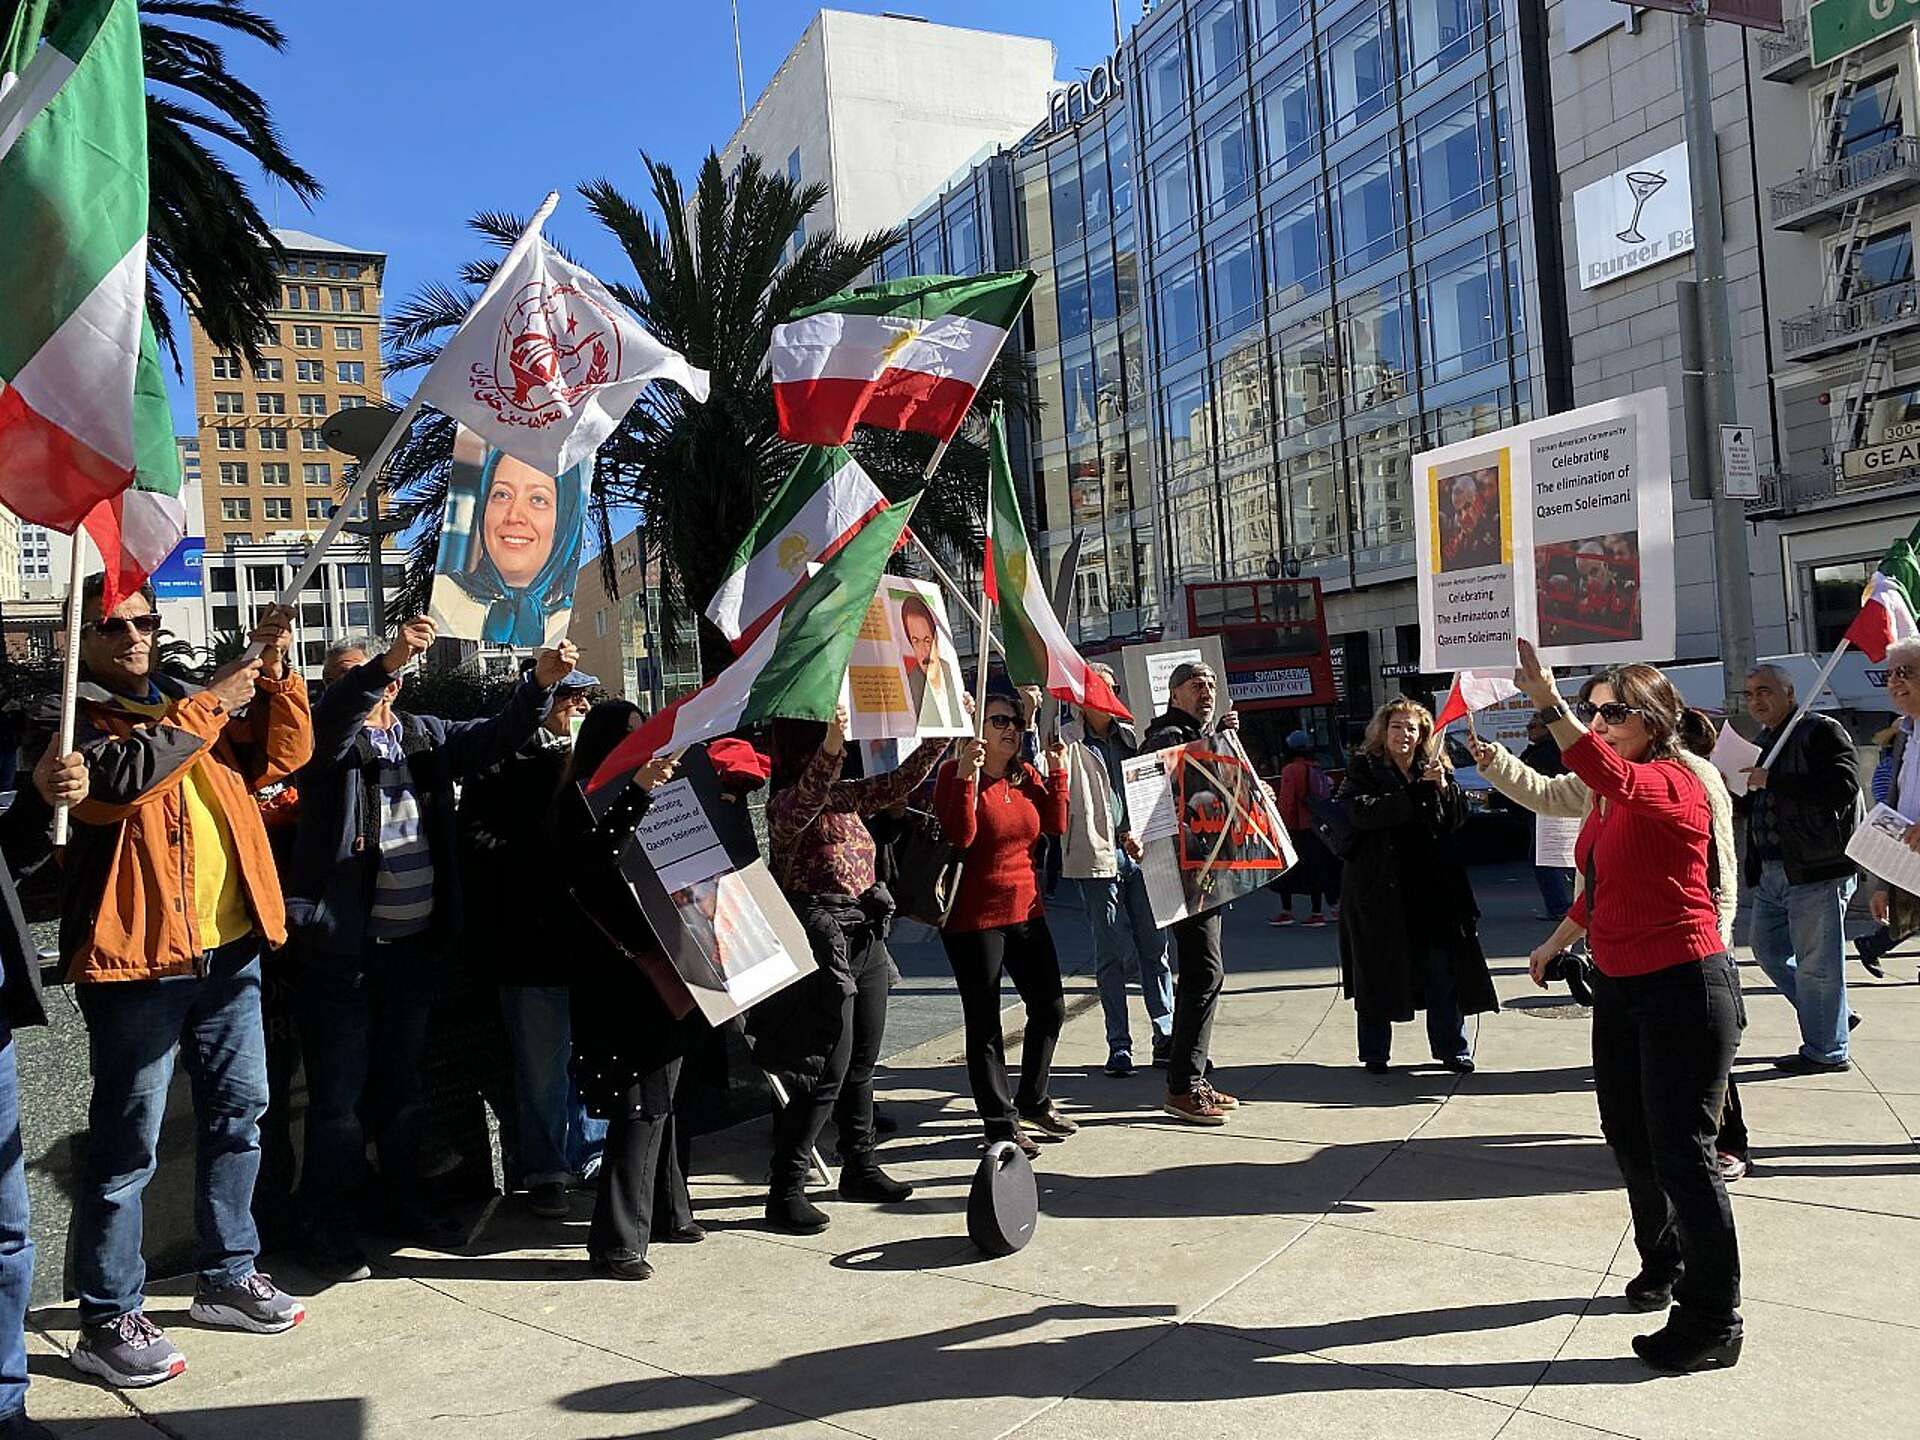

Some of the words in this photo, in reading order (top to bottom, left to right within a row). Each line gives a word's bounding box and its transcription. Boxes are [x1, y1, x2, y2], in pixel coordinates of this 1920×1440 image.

[1588, 240, 1662, 281] Burger
[1558, 436, 1587, 448] American
[1588, 427, 1627, 441] Community
[1552, 448, 1609, 469] Celebrating
[1865, 443, 1920, 468] GEA
[1536, 481, 1555, 495] The
[1556, 470, 1615, 491] elimination
[1617, 464, 1630, 479] of
[1537, 503, 1573, 518] Qasem
[1575, 488, 1632, 511] Soleimani
[1448, 589, 1494, 604] Celebrating
[1437, 613, 1451, 624] The
[1453, 608, 1499, 623] elimination
[1501, 605, 1511, 619] of
[1438, 634, 1466, 647] Qasem
[1467, 629, 1512, 644] Soleimani
[1255, 668, 1310, 682] SIGHTSEEING
[1383, 665, 1408, 675] RETAIL
[1250, 684, 1264, 695] ON
[1267, 682, 1285, 693] HOP
[1286, 681, 1304, 692] OFF
[638, 825, 653, 837] The
[653, 812, 692, 831] elimination
[645, 836, 673, 851] Qasem
[671, 822, 709, 841] Soleimani
